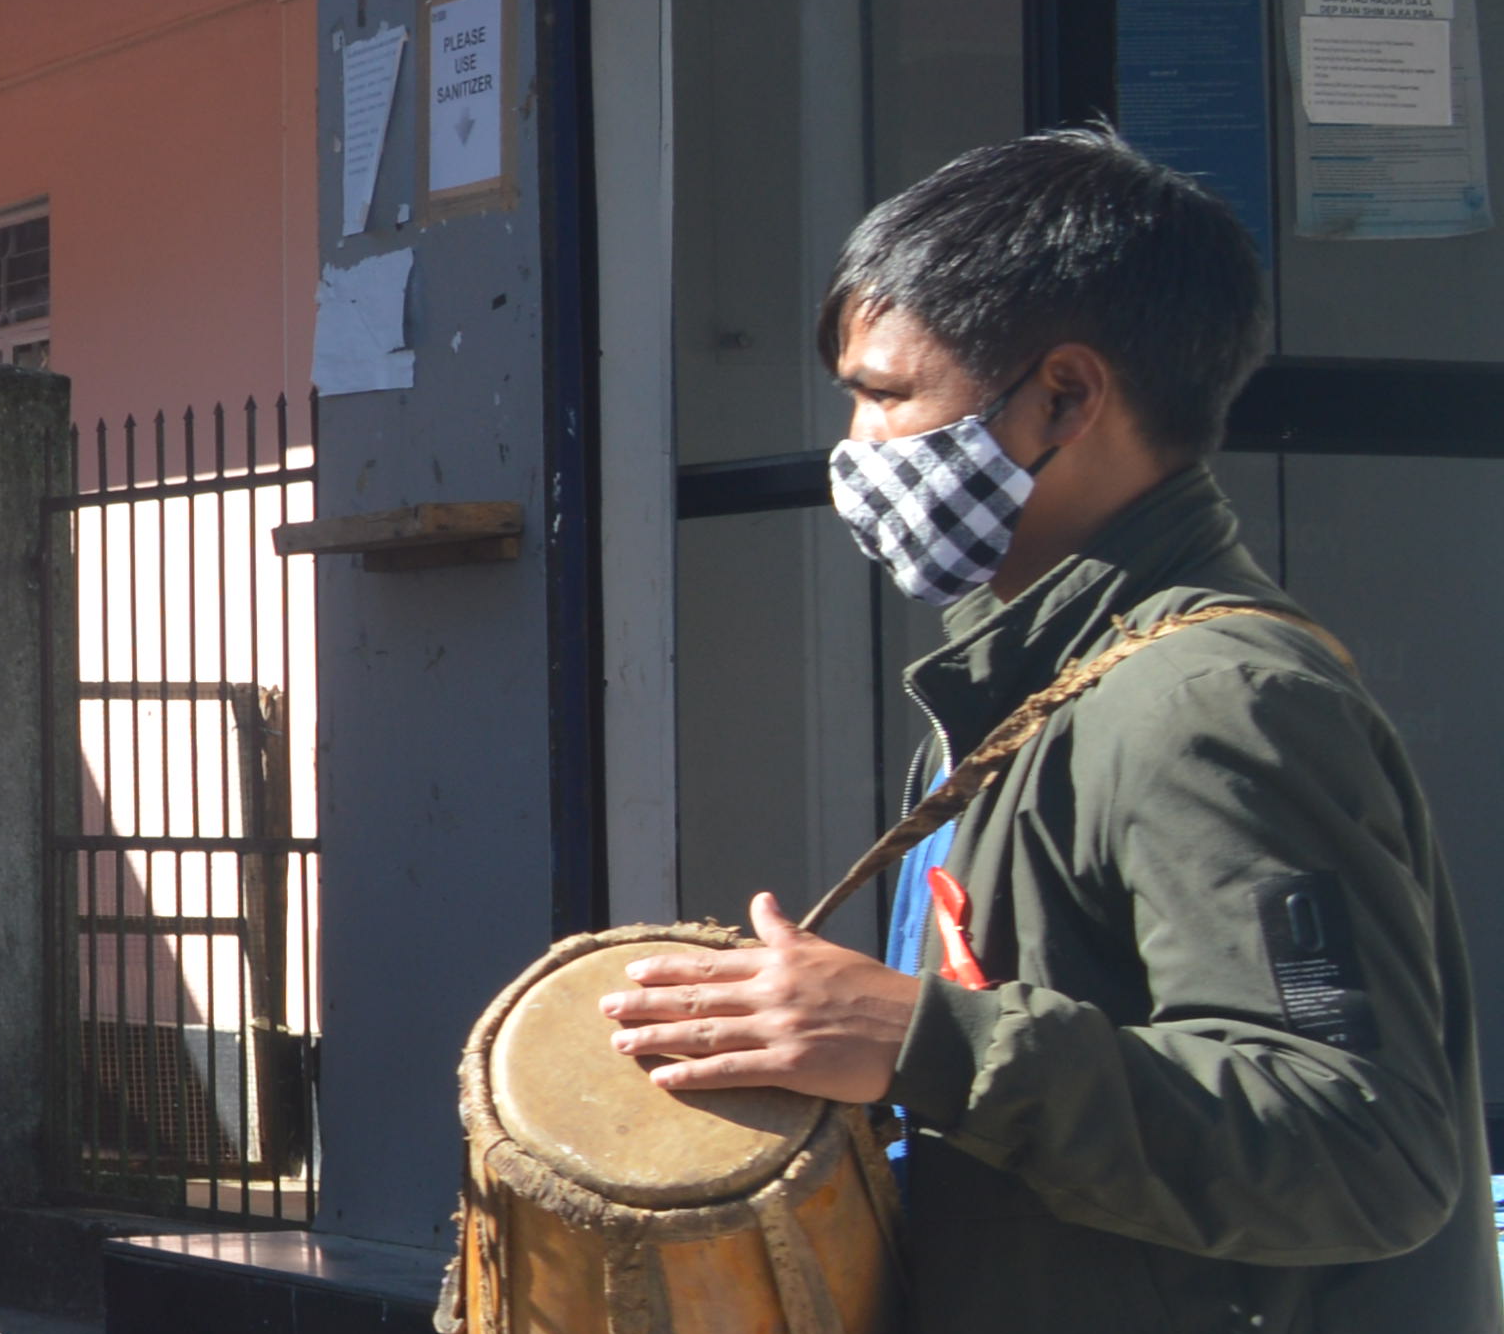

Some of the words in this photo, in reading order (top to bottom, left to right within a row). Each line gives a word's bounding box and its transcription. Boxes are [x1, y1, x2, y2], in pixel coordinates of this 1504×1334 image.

[444, 26, 486, 52] PLEASE
[454, 54, 476, 74] USE
[438, 74, 493, 103] SANITIZER
